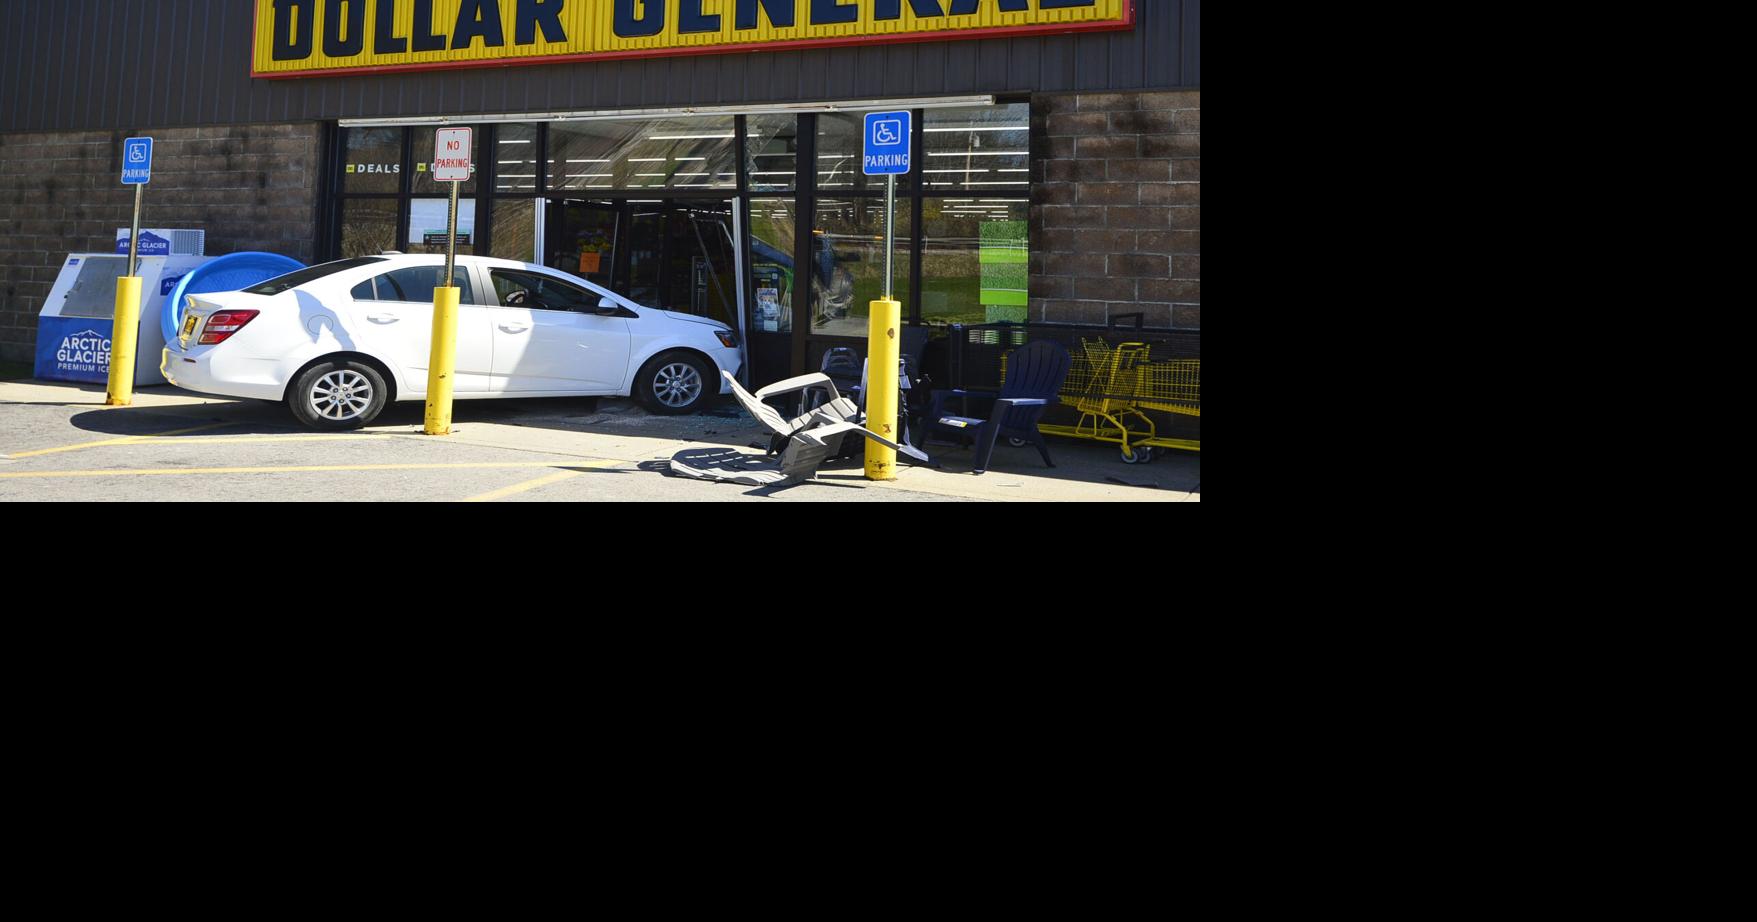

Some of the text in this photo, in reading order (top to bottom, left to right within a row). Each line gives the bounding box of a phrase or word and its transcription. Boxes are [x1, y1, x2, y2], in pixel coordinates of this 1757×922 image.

[272, 0, 568, 61] DOLLAR
[447, 141, 460, 150] NO
[437, 158, 468, 168] PARKING
[865, 154, 908, 167] PARKING
[357, 164, 400, 173] DEALS
[122, 169, 150, 178] PARKING
[61, 337, 111, 351] ARCTIC
[57, 363, 95, 372] PREMIUM
